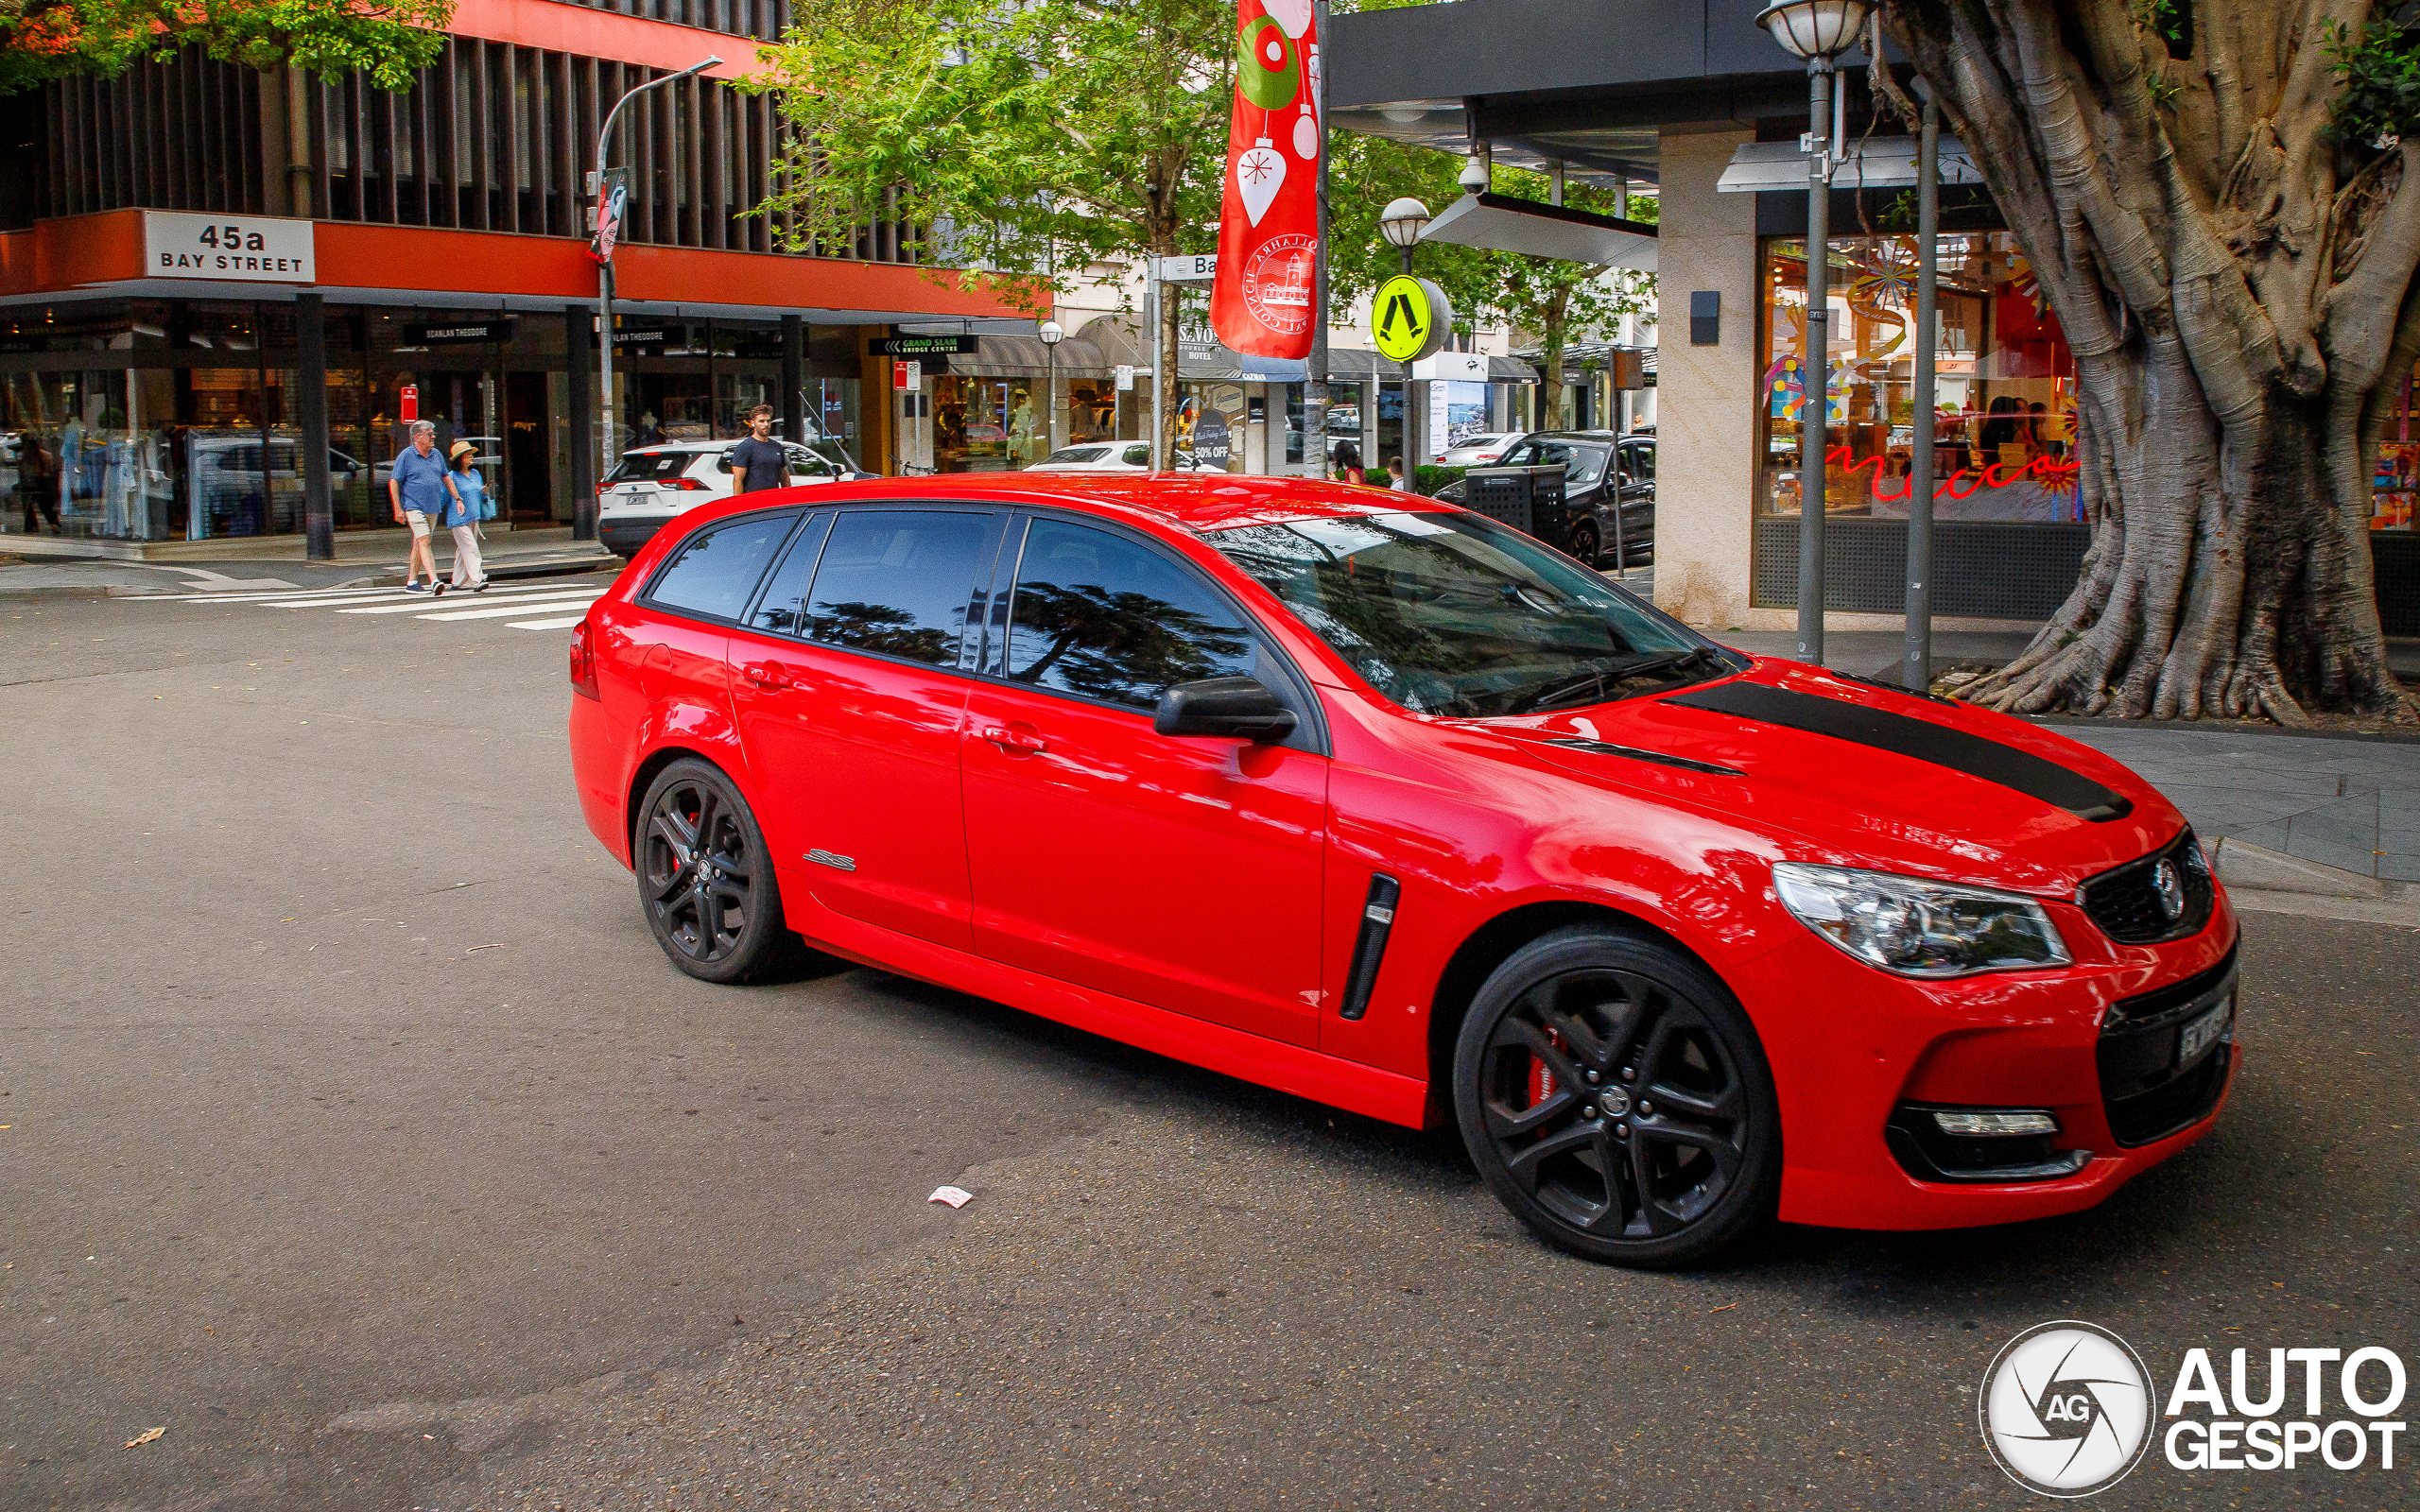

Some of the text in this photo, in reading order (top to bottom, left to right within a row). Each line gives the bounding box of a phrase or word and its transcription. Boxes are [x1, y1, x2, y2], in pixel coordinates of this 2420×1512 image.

[199, 225, 265, 251] 45a
[161, 252, 302, 272] BAY STREET
[1194, 257, 1217, 274] Ba
[455, 327, 488, 336] THEODORE
[630, 332, 664, 341] THEODORE
[902, 339, 932, 348] GRAND
[1188, 352, 1212, 361] HOTEL
[1194, 446, 1229, 459] 50% OFF
[1539, 1063, 1551, 1101] bremb
